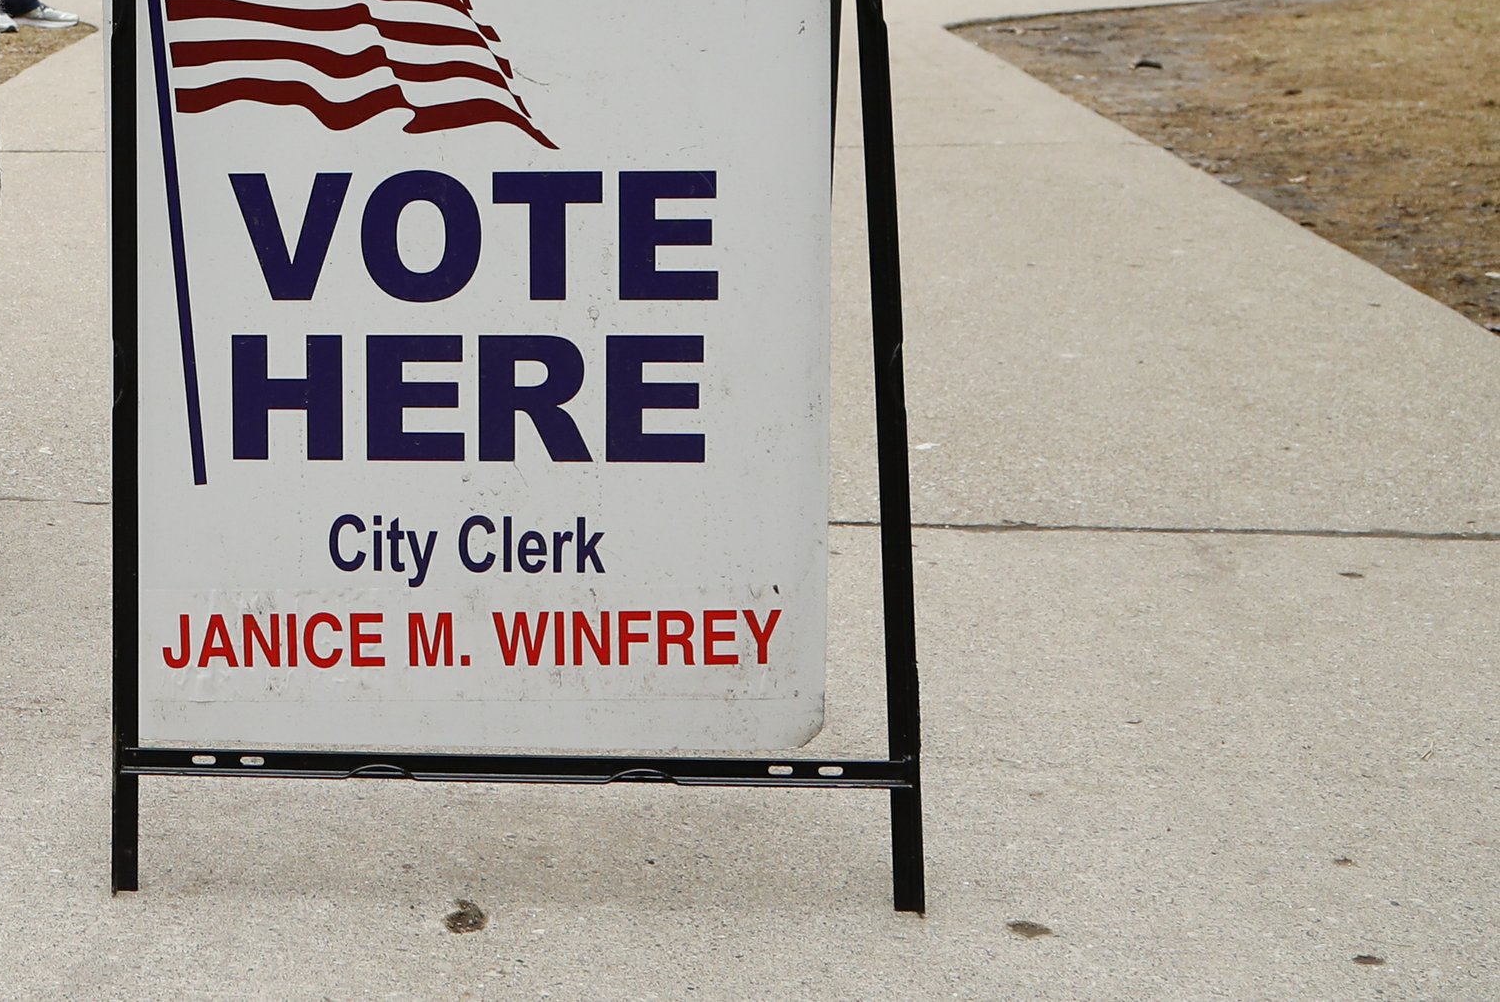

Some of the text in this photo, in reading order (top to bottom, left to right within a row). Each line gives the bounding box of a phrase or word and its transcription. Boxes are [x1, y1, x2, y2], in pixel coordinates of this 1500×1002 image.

[228, 170, 719, 302] VOTE
[231, 334, 706, 463] HERE
[329, 514, 606, 588] City Clerk
[163, 609, 782, 670] JANICE M. WINFREY
